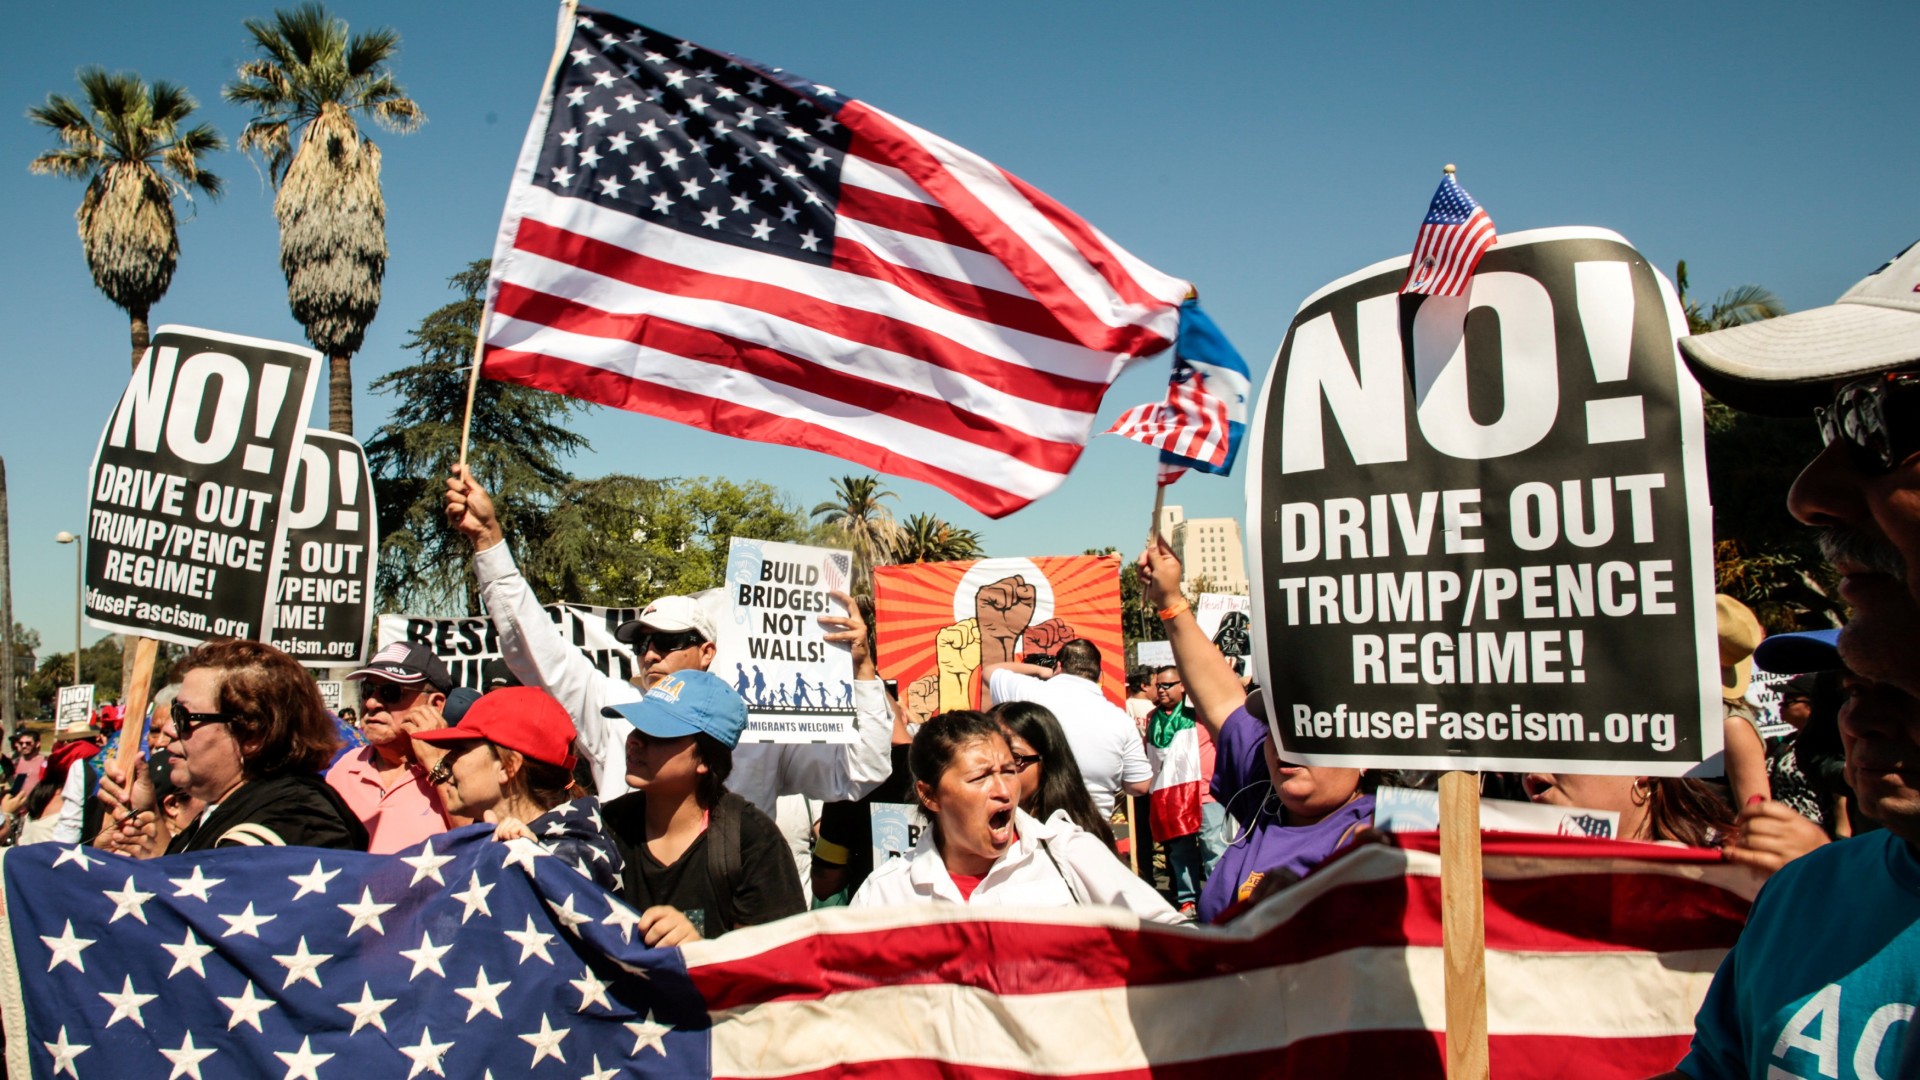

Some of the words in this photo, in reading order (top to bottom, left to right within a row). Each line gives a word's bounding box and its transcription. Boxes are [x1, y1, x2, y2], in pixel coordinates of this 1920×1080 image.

[1282, 260, 1646, 474] NO!
[109, 345, 292, 474] NO!
[96, 463, 187, 516] DRIVE
[195, 481, 272, 532] OUT
[288, 443, 359, 531] O!
[90, 508, 266, 572] TRUMP/PENCE
[1281, 488, 1485, 563] DRIVE
[1508, 473, 1666, 551] OUT
[103, 549, 217, 600] REGIME!
[300, 541, 363, 575] OUT
[760, 559, 819, 587] BUILD
[273, 604, 326, 630] IME!
[738, 583, 830, 613] BRIDGES!
[1279, 559, 1677, 627] TRUMP/PENCE
[748, 637, 825, 663] WALLS!
[762, 612, 806, 637] NOT
[1352, 629, 1586, 685] REGIME!
[744, 721, 797, 732] MIGRANTS
[798, 722, 844, 733] WELCOME!
[1292, 703, 1675, 752] RefuseFascism.org
